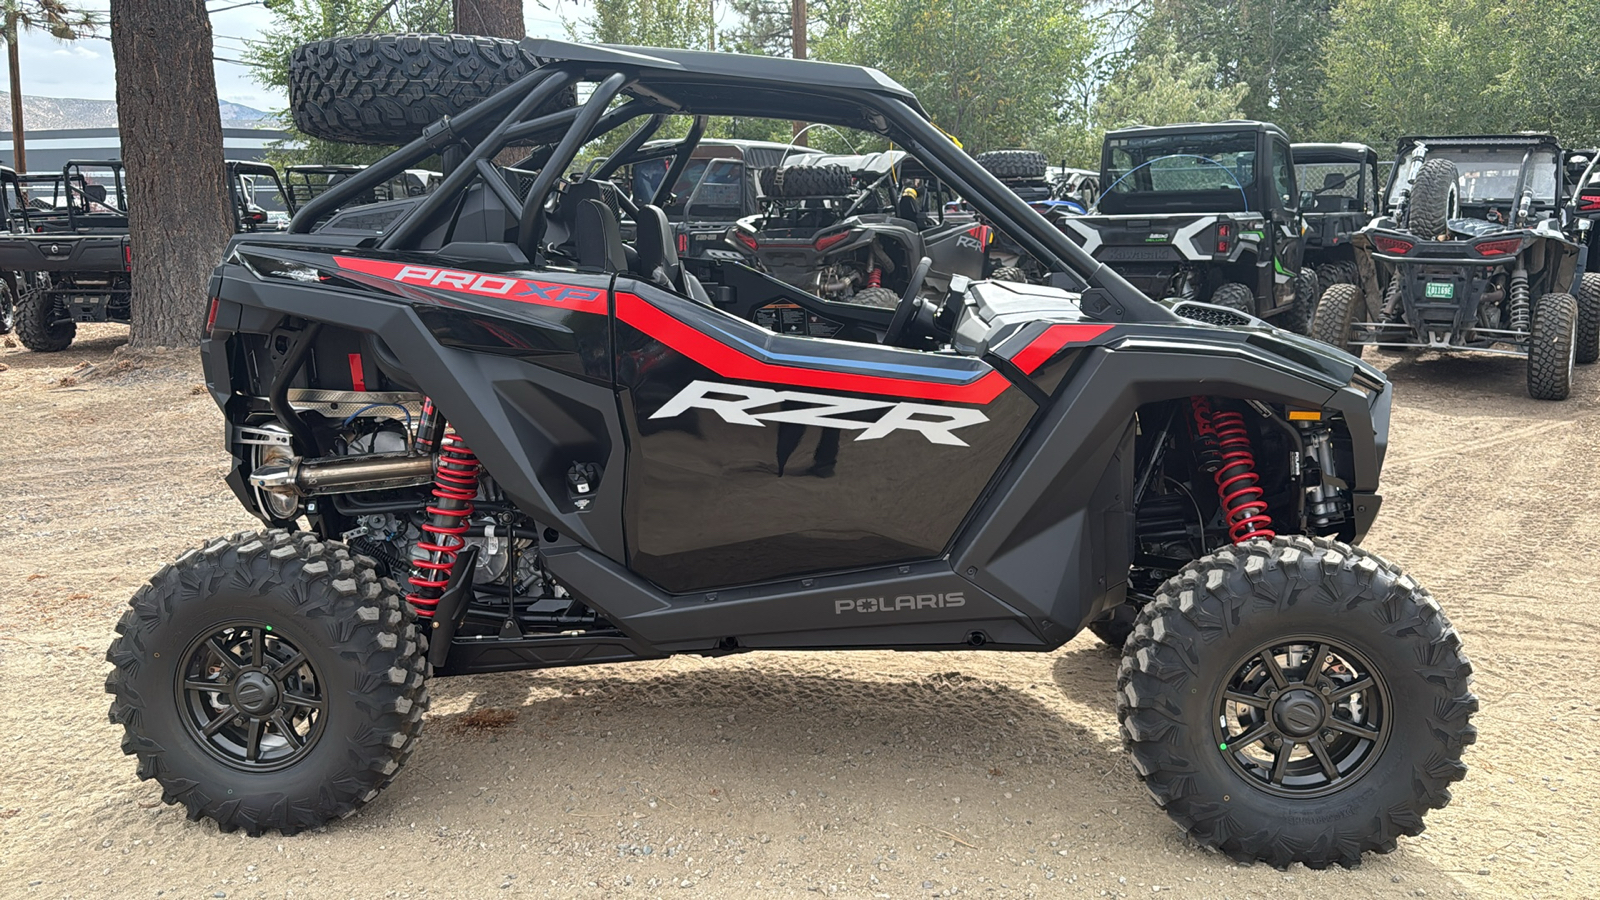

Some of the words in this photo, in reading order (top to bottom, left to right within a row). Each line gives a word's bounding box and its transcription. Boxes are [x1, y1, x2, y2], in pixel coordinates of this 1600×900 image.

[956, 235, 982, 252] RZR
[1108, 249, 1169, 259] Kawasaki
[393, 265, 518, 295] PRO
[514, 282, 601, 302] XP
[647, 379, 991, 448] RZR
[834, 591, 966, 615] POLARIS
